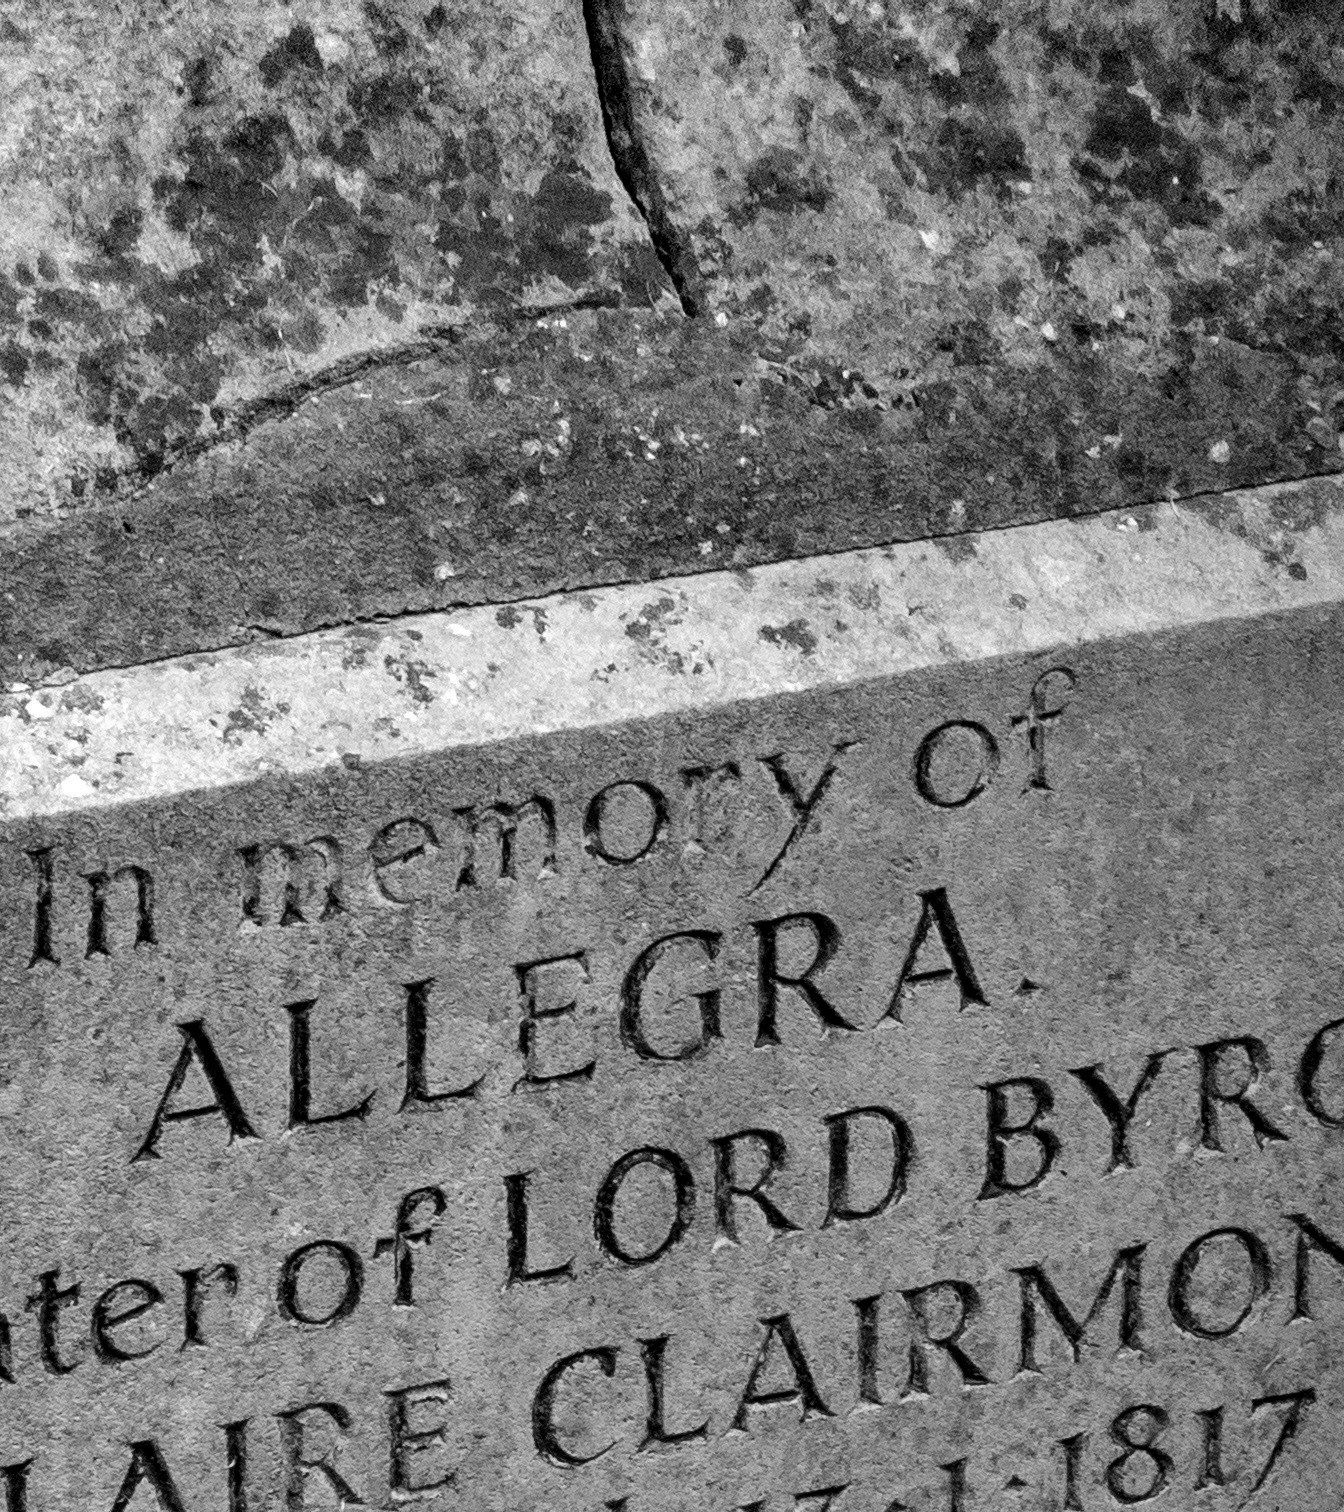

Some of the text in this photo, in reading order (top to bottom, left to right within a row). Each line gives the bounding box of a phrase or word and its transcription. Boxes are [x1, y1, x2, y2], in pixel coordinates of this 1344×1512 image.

[26, 665, 1076, 970] In memory of
[275, 1184, 449, 1328] of
[499, 1105, 914, 1292] LORD
